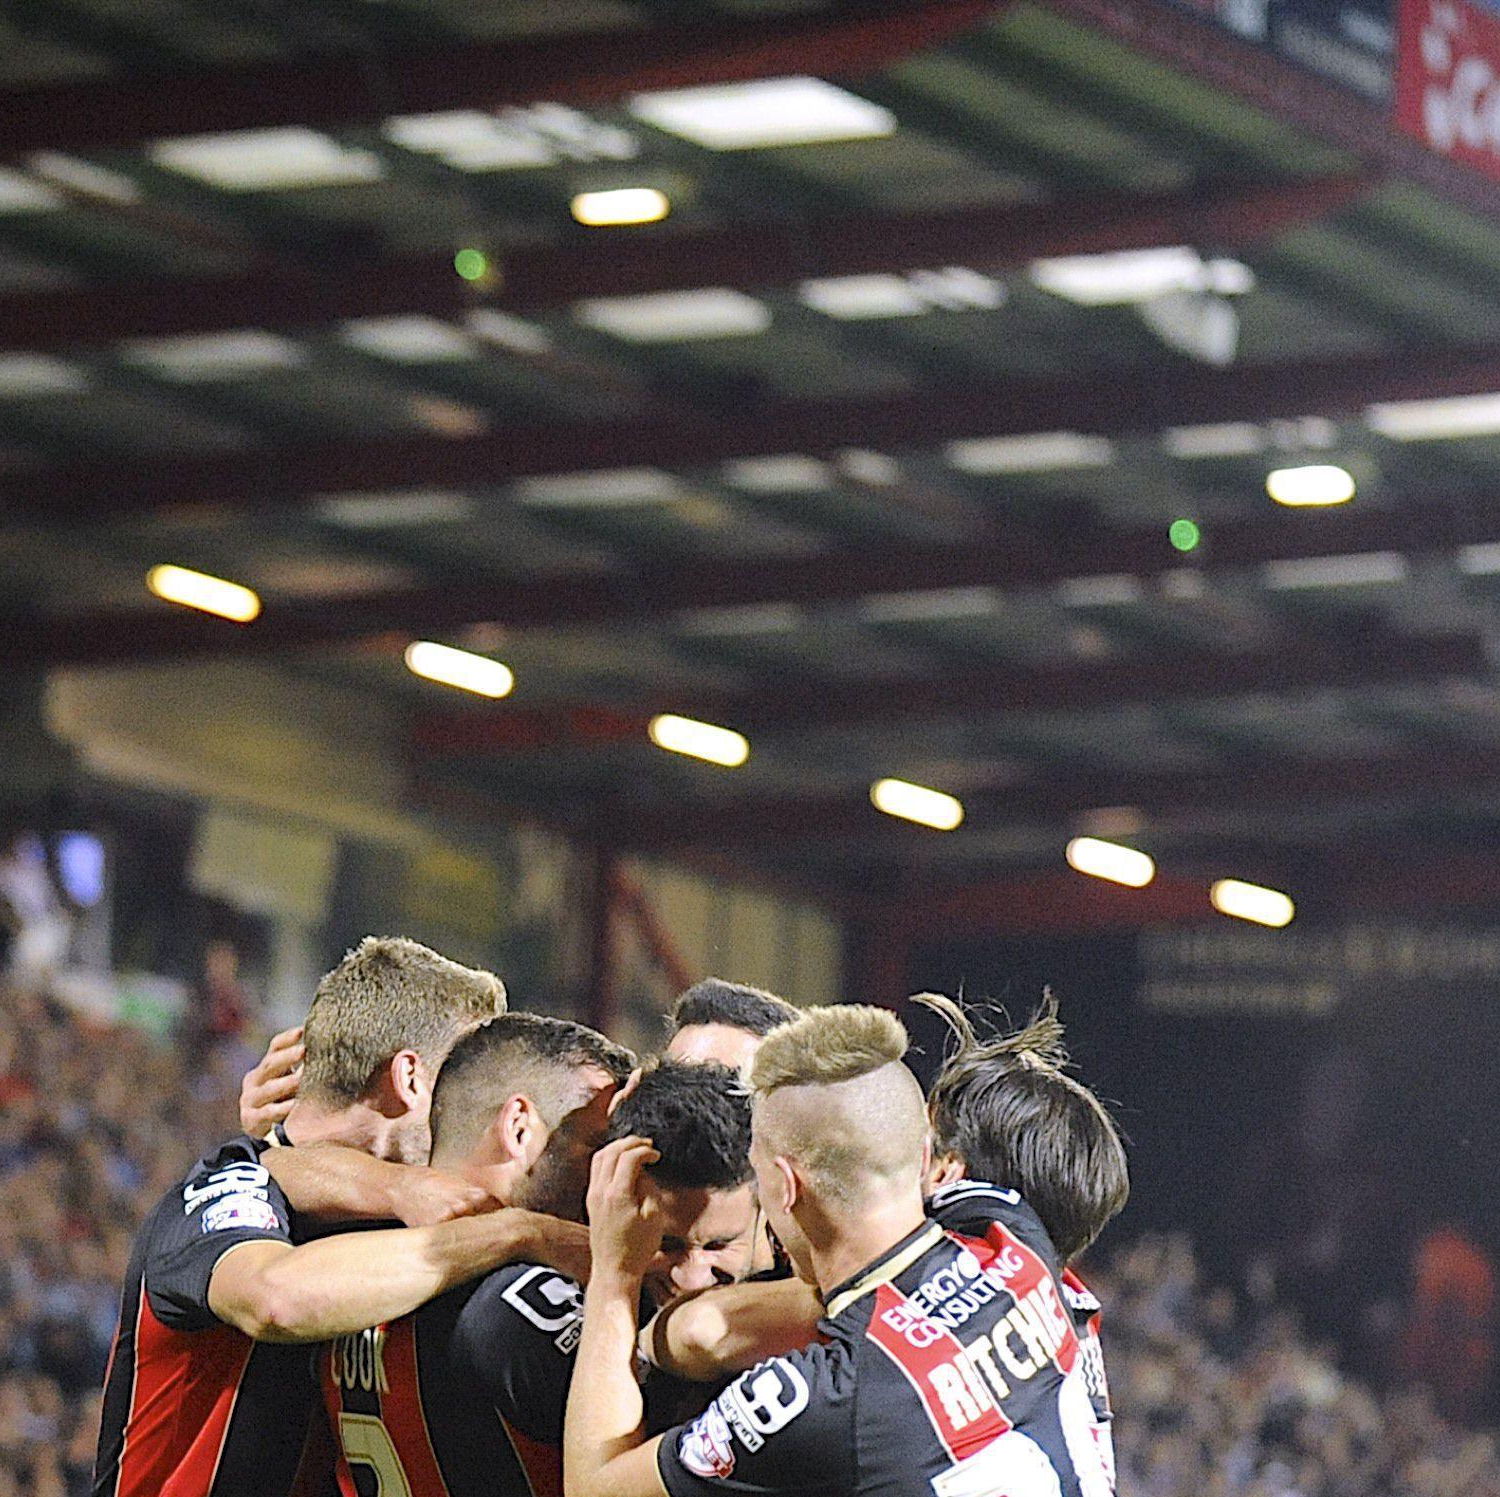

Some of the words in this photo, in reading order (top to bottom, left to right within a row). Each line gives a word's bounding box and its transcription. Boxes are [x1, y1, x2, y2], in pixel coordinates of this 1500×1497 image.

[881, 1261, 964, 1332] ENERGY
[904, 1246, 1024, 1348] CONSULTING
[927, 1275, 1068, 1431] RITCHIE
